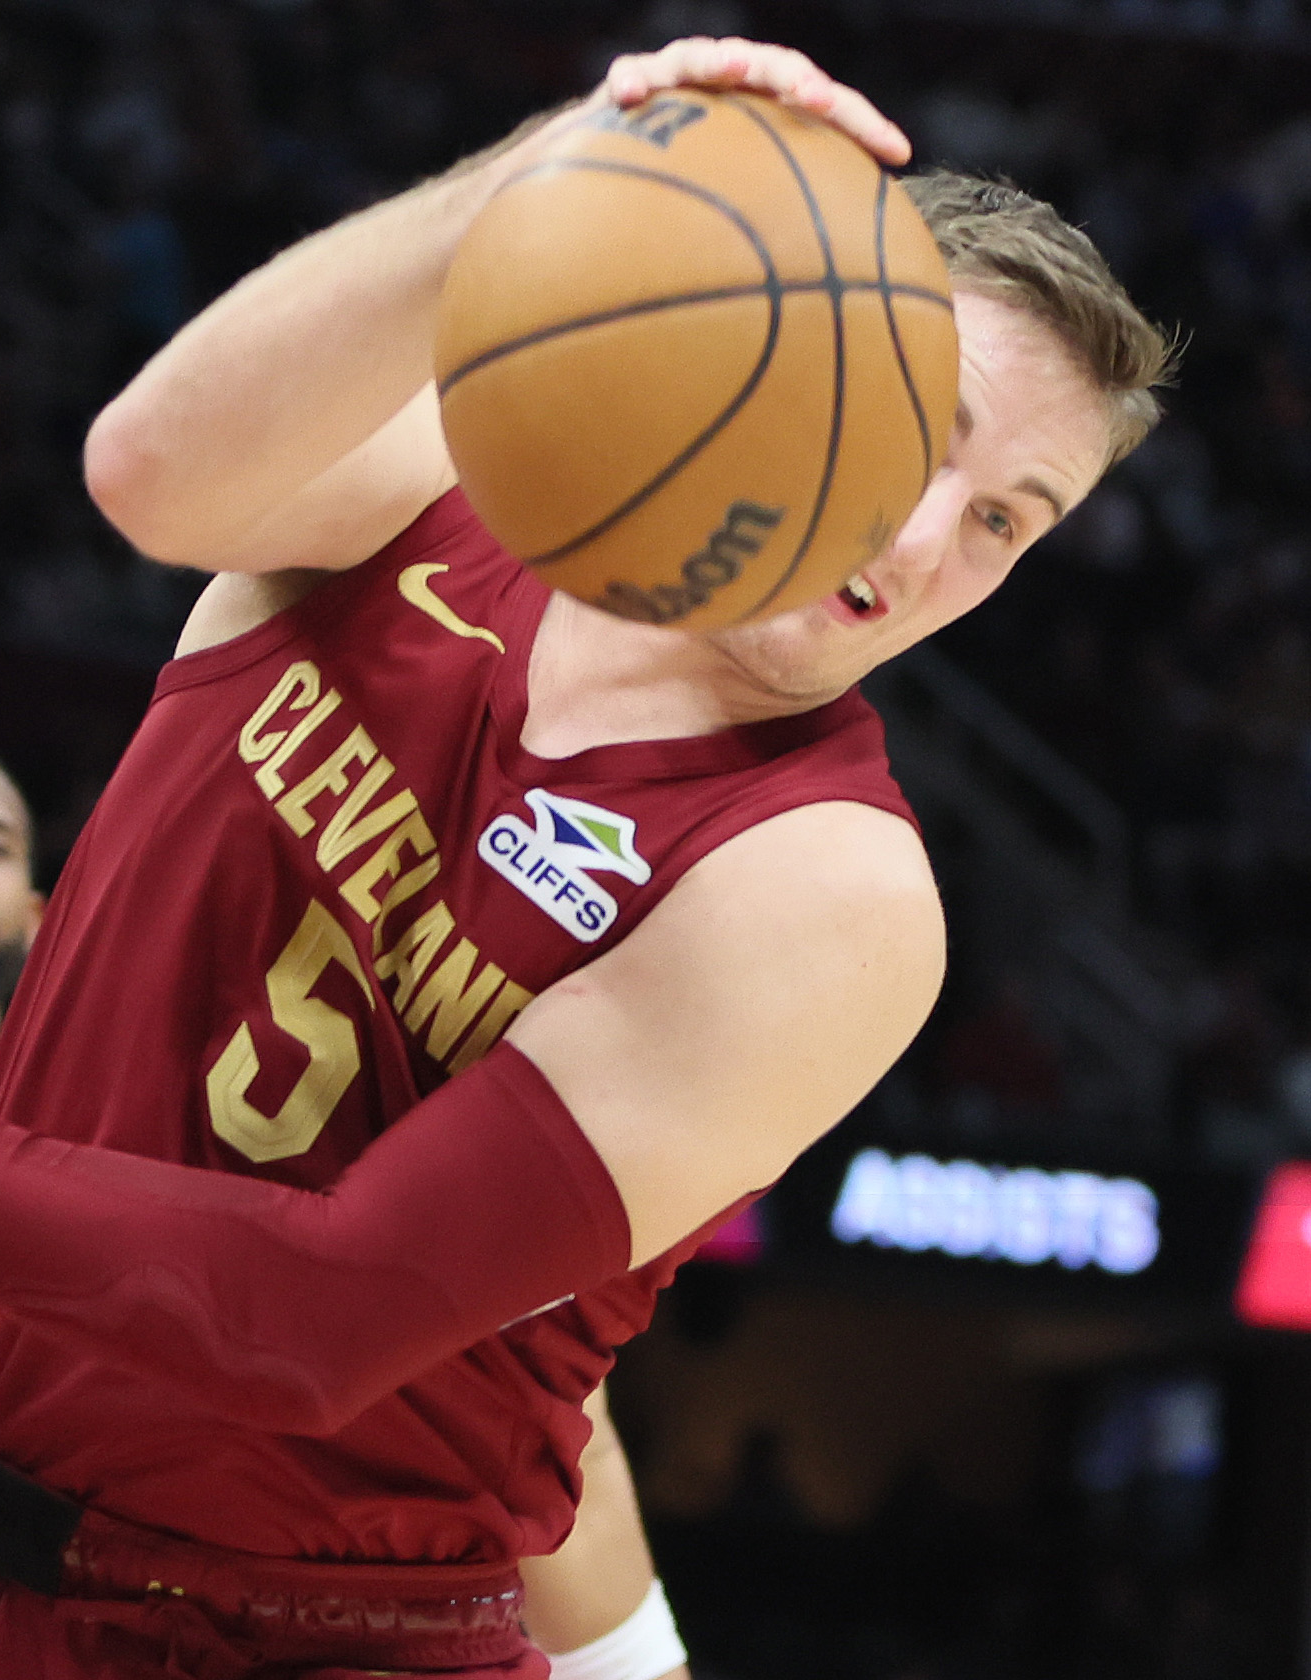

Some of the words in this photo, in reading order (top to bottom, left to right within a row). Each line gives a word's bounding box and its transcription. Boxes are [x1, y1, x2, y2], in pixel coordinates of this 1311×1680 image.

[594, 500, 786, 626] lson
[489, 827, 606, 931] CLIFFS
[206, 898, 377, 1163] 5
